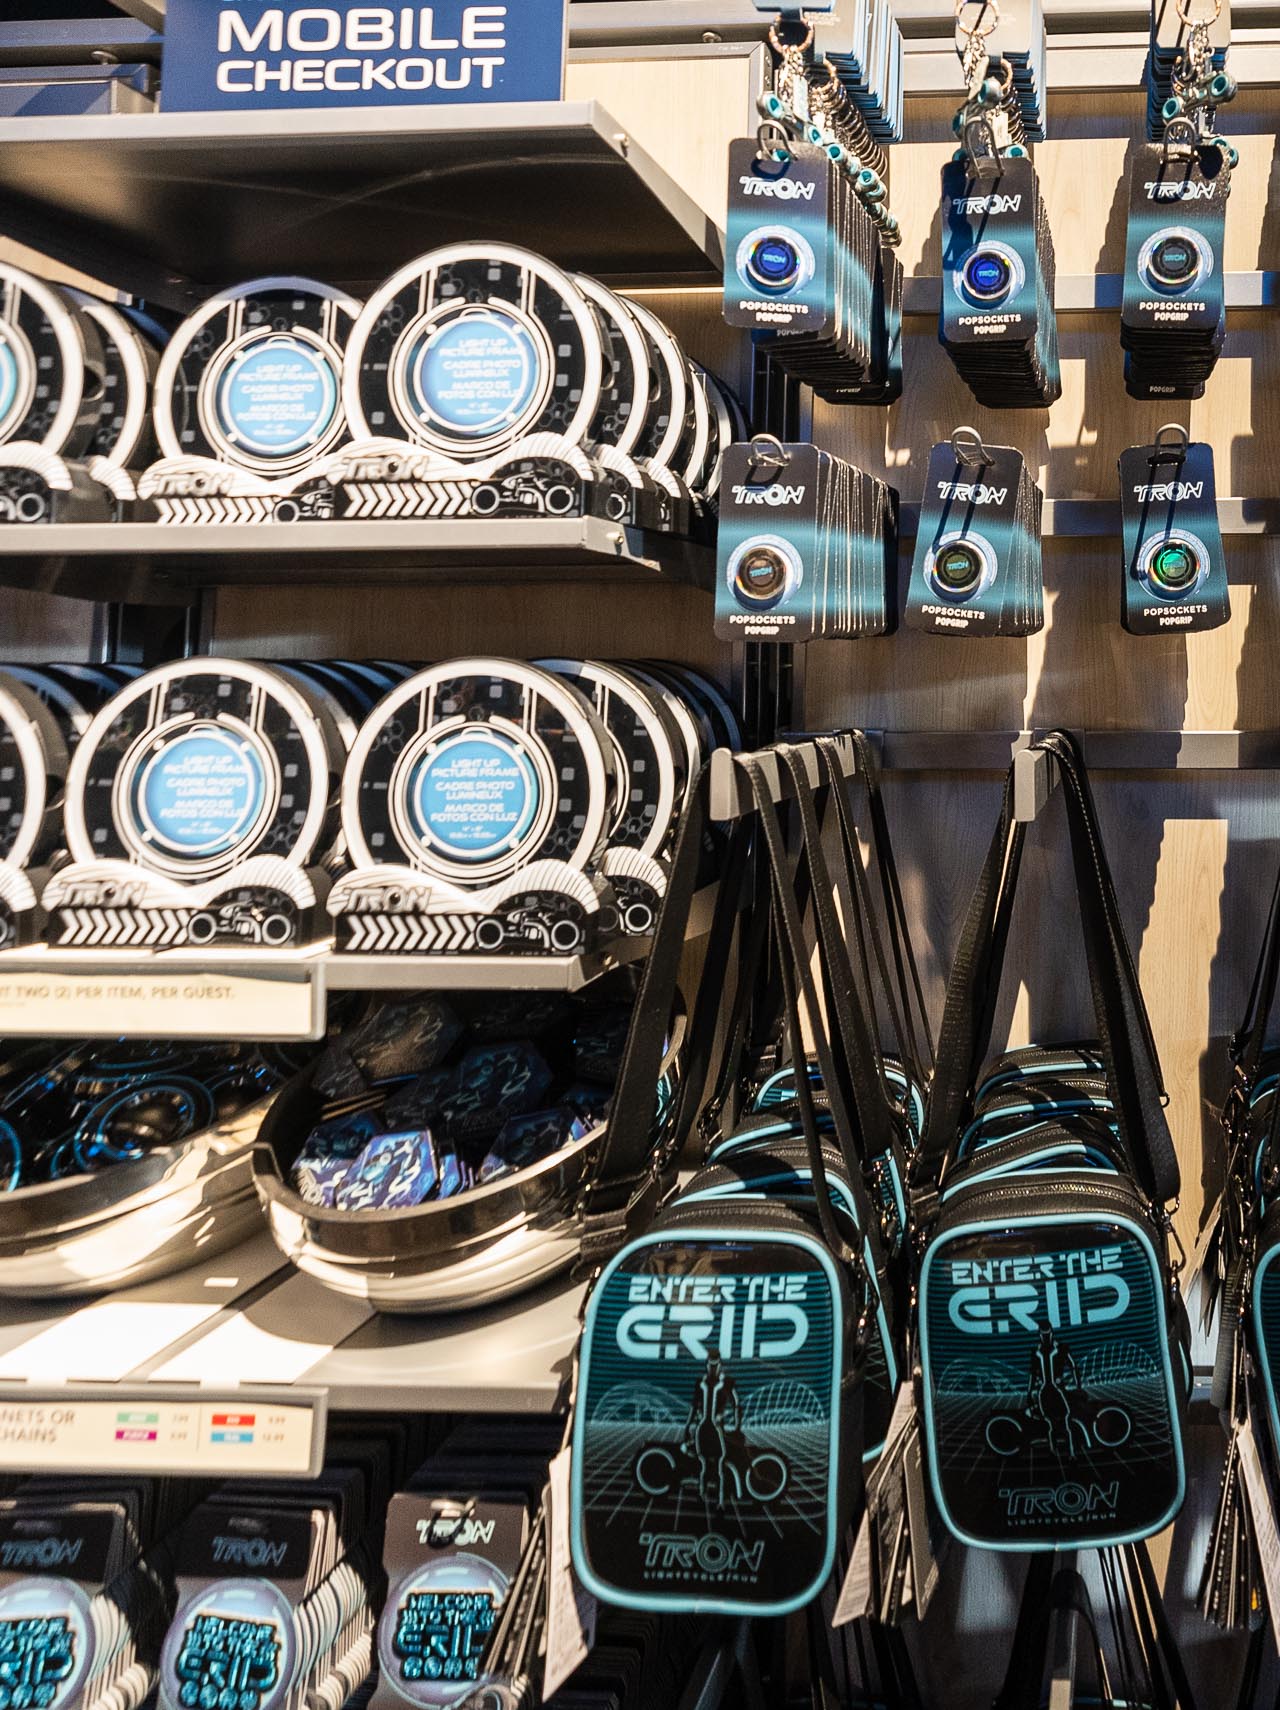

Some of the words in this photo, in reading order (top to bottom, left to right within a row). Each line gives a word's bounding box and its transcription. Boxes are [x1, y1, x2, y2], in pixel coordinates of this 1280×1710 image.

[217, 6, 508, 52] MOBILE
[216, 56, 506, 92] CHECKOUT
[739, 176, 816, 200] TRON
[1143, 180, 1217, 201] TRON
[953, 194, 1022, 215] TRON
[740, 301, 809, 314] POPSOCKETS
[1139, 302, 1206, 311] POPSOCKETS
[756, 311, 792, 323] POPGRIP
[958, 314, 1022, 325] POPSOCKETS
[1154, 312, 1189, 321] POPGRIP
[973, 324, 1007, 335] POPGRIP
[731, 483, 805, 506] TRON
[937, 481, 1007, 505] TRON
[1133, 481, 1203, 502] TRON
[922, 604, 986, 620] POPSOCKETS
[1144, 604, 1208, 617] POPSOCKETS
[729, 615, 796, 625] POPSOCKETS
[935, 617, 969, 628] POPGRIP
[1159, 616, 1193, 626] POPGRIP
[745, 625, 779, 635] POPGRIP
[452, 759, 482, 767] LIGHT
[484, 759, 500, 767] UP
[431, 767, 477, 777] PICTURE
[480, 767, 520, 777] FRAME
[435, 781, 474, 791] CADRE
[476, 781, 516, 791] PHOTO
[446, 791, 503, 800] LUMINEUX
[444, 803, 487, 812] MARCO
[489, 803, 504, 812] DE
[430, 812, 467, 822] FOTOS
[470, 812, 494, 822] CON
[495, 812, 518, 822] LUZ
[16, 986, 49, 998] TWO
[76, 986, 101, 998] PER
[152, 986, 177, 998] PER
[951, 1256, 1054, 1285] ENTER
[1059, 1246, 1123, 1276] THE
[628, 1275, 737, 1303] ENTER
[743, 1275, 808, 1302] THE
[948, 1273, 1130, 1334] GRID
[616, 1303, 809, 1360] GRID
[50, 1409, 75, 1424] OR
[999, 1481, 1119, 1515] TRON
[213, 1536, 288, 1567] TRON
[639, 1532, 765, 1572] TRON
